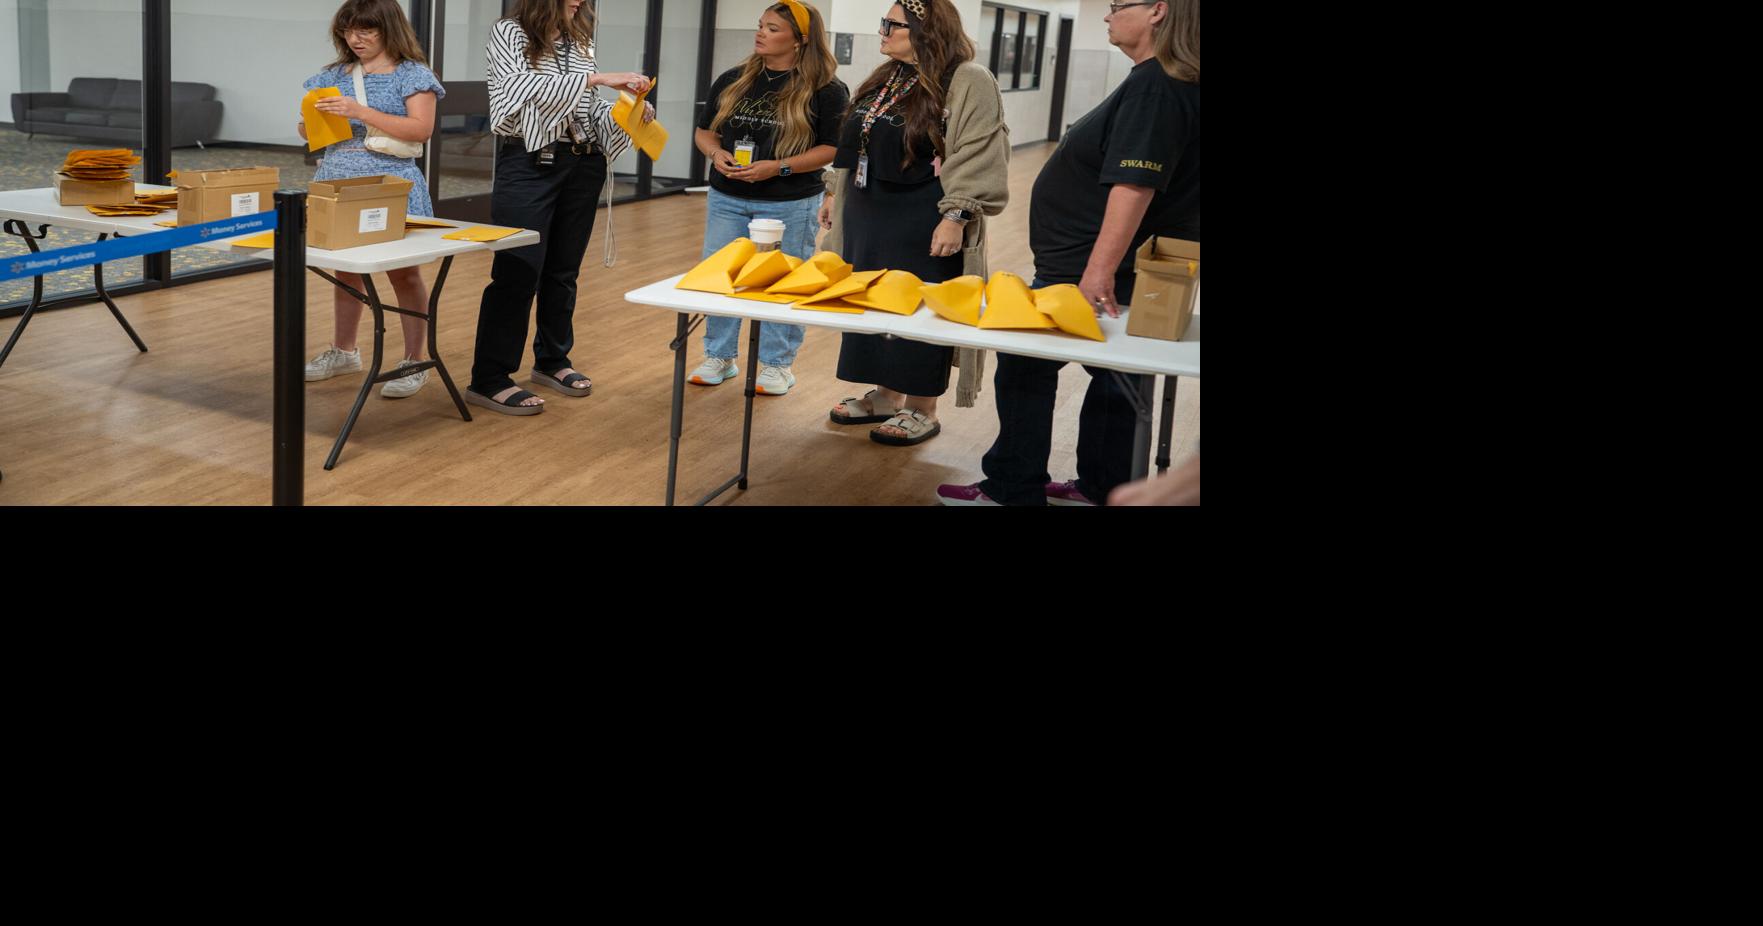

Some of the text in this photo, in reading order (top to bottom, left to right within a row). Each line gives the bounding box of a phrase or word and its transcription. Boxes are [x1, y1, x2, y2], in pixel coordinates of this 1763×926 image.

[1120, 160, 1162, 171] SWARM
[211, 220, 263, 234] Money Services
[26, 251, 96, 269] Money Services
